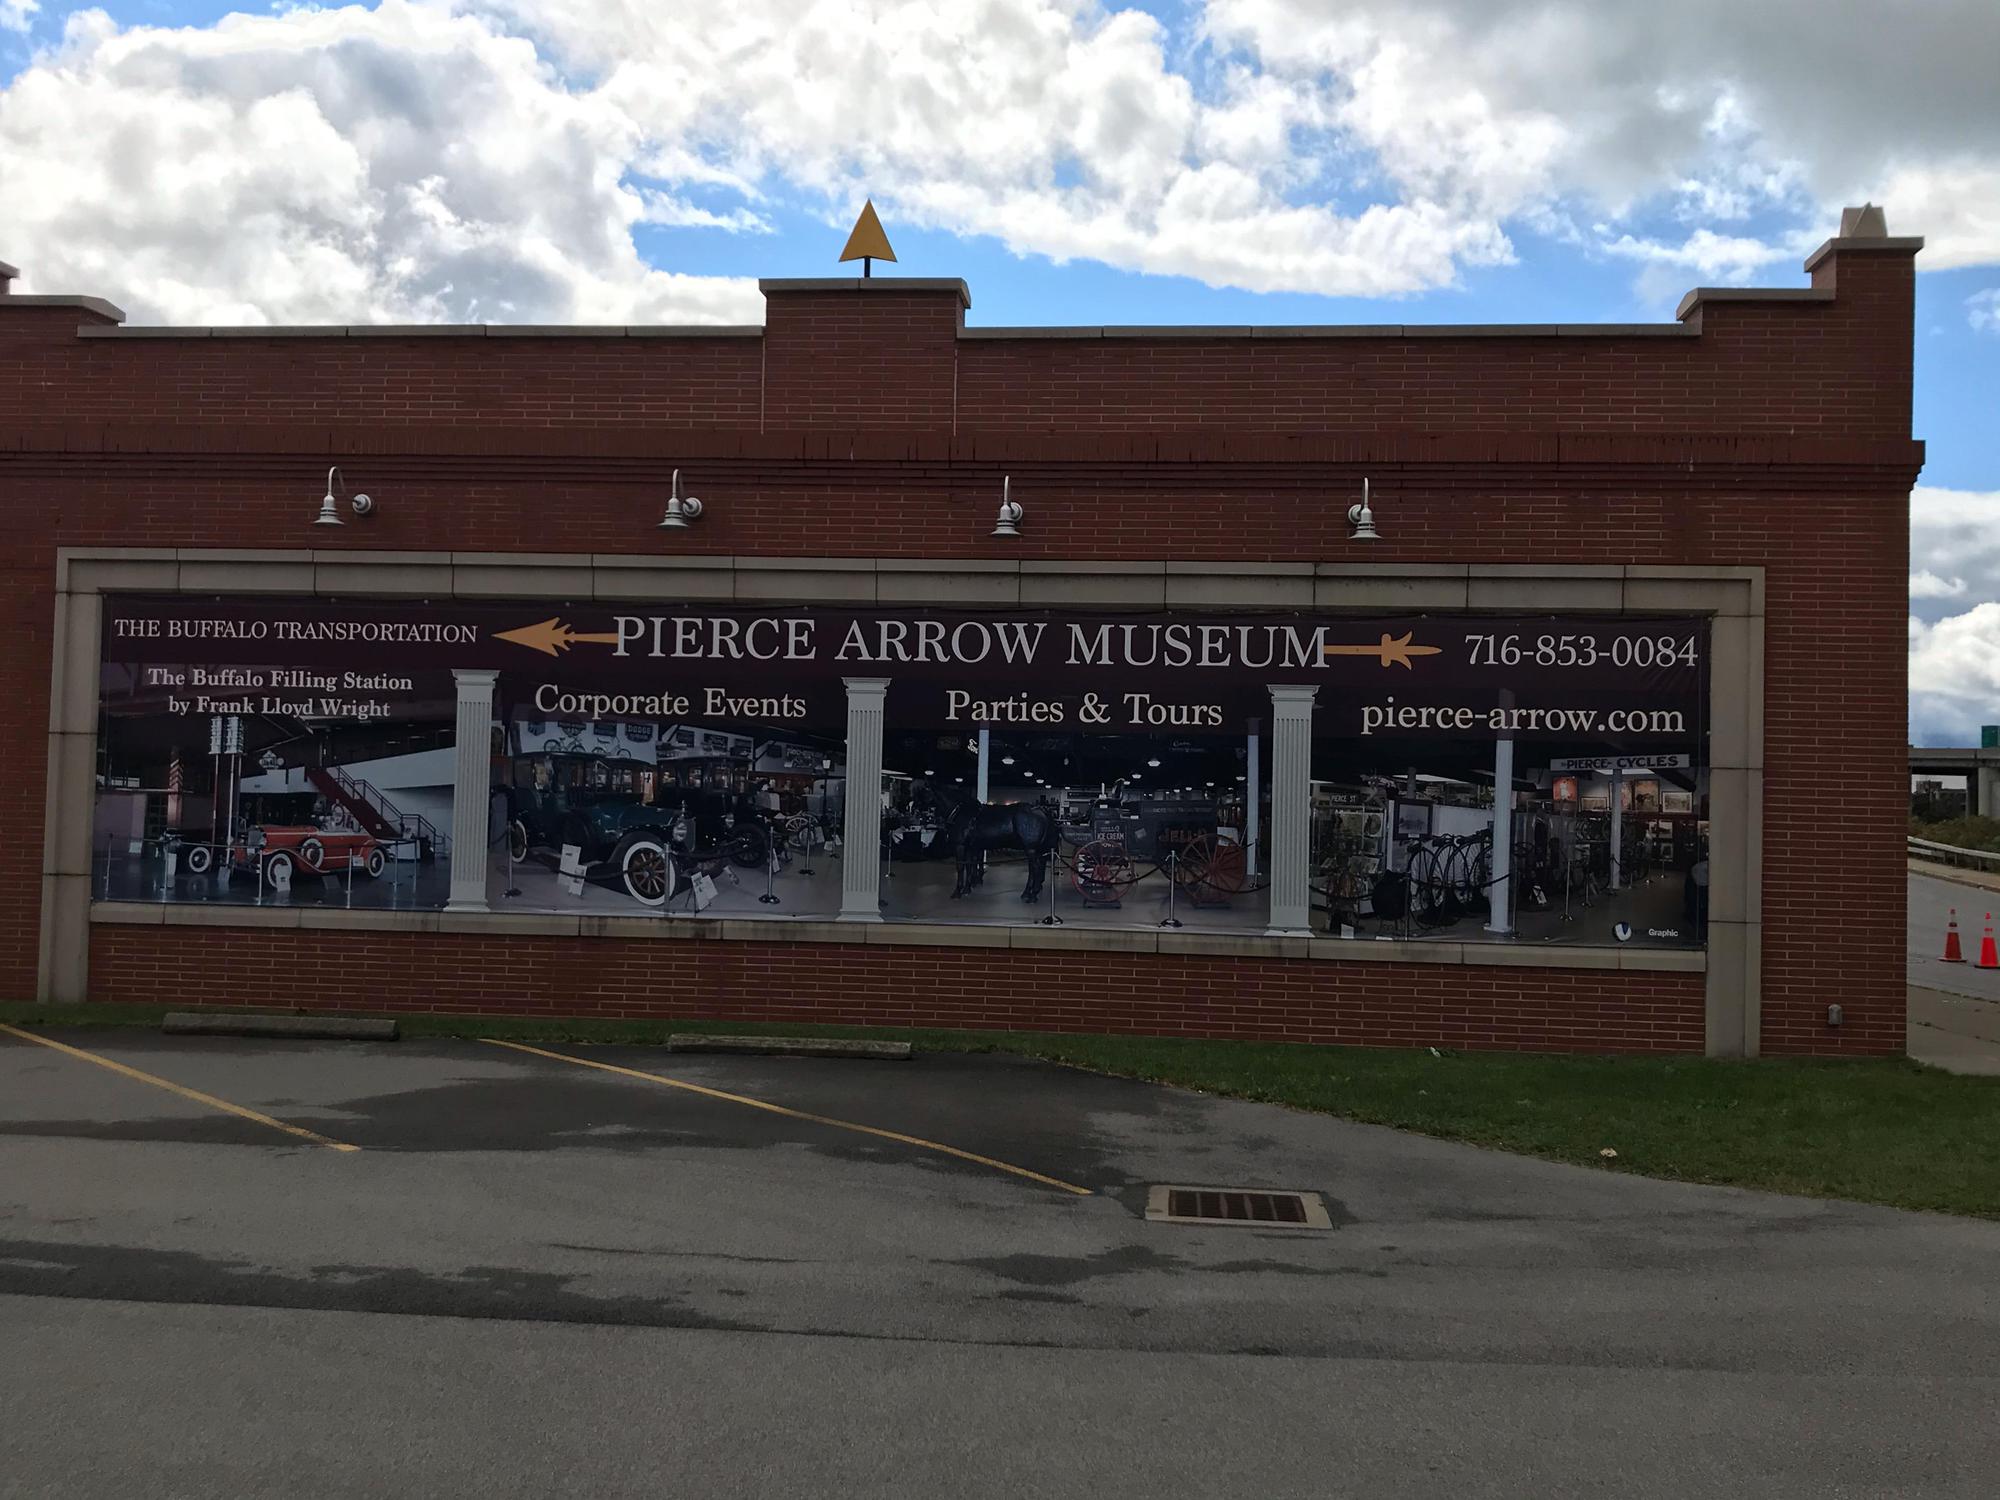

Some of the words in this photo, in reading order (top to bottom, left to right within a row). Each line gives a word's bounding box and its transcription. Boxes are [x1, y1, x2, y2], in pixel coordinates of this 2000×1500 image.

[114, 619, 160, 637] THE
[168, 620, 267, 639] BUFFALO
[274, 621, 477, 643] TRANSPORTATION
[612, 616, 816, 660] PIERCE
[834, 619, 1048, 664] ARROW
[1065, 623, 1330, 668] MUSEUM
[1465, 634, 1698, 667] 716-853-0084
[147, 668, 185, 686] The
[191, 668, 264, 687] Buffalo
[270, 670, 338, 692] Filling
[343, 671, 413, 690] Station
[169, 695, 190, 714] by
[196, 695, 255, 713] Frank
[261, 697, 314, 716] Lloyd
[319, 698, 390, 719] Wright
[535, 684, 689, 719] Corporate
[703, 687, 806, 718] Events
[945, 690, 1064, 723] Parties
[1079, 692, 1111, 723] &
[1123, 693, 1223, 726] Tours
[1361, 696, 1686, 735] pierce-arrow.com
[1616, 756, 1679, 768] CYCLES
[1106, 833, 1124, 841] CREAM
[1648, 928, 1679, 938] Graphic
